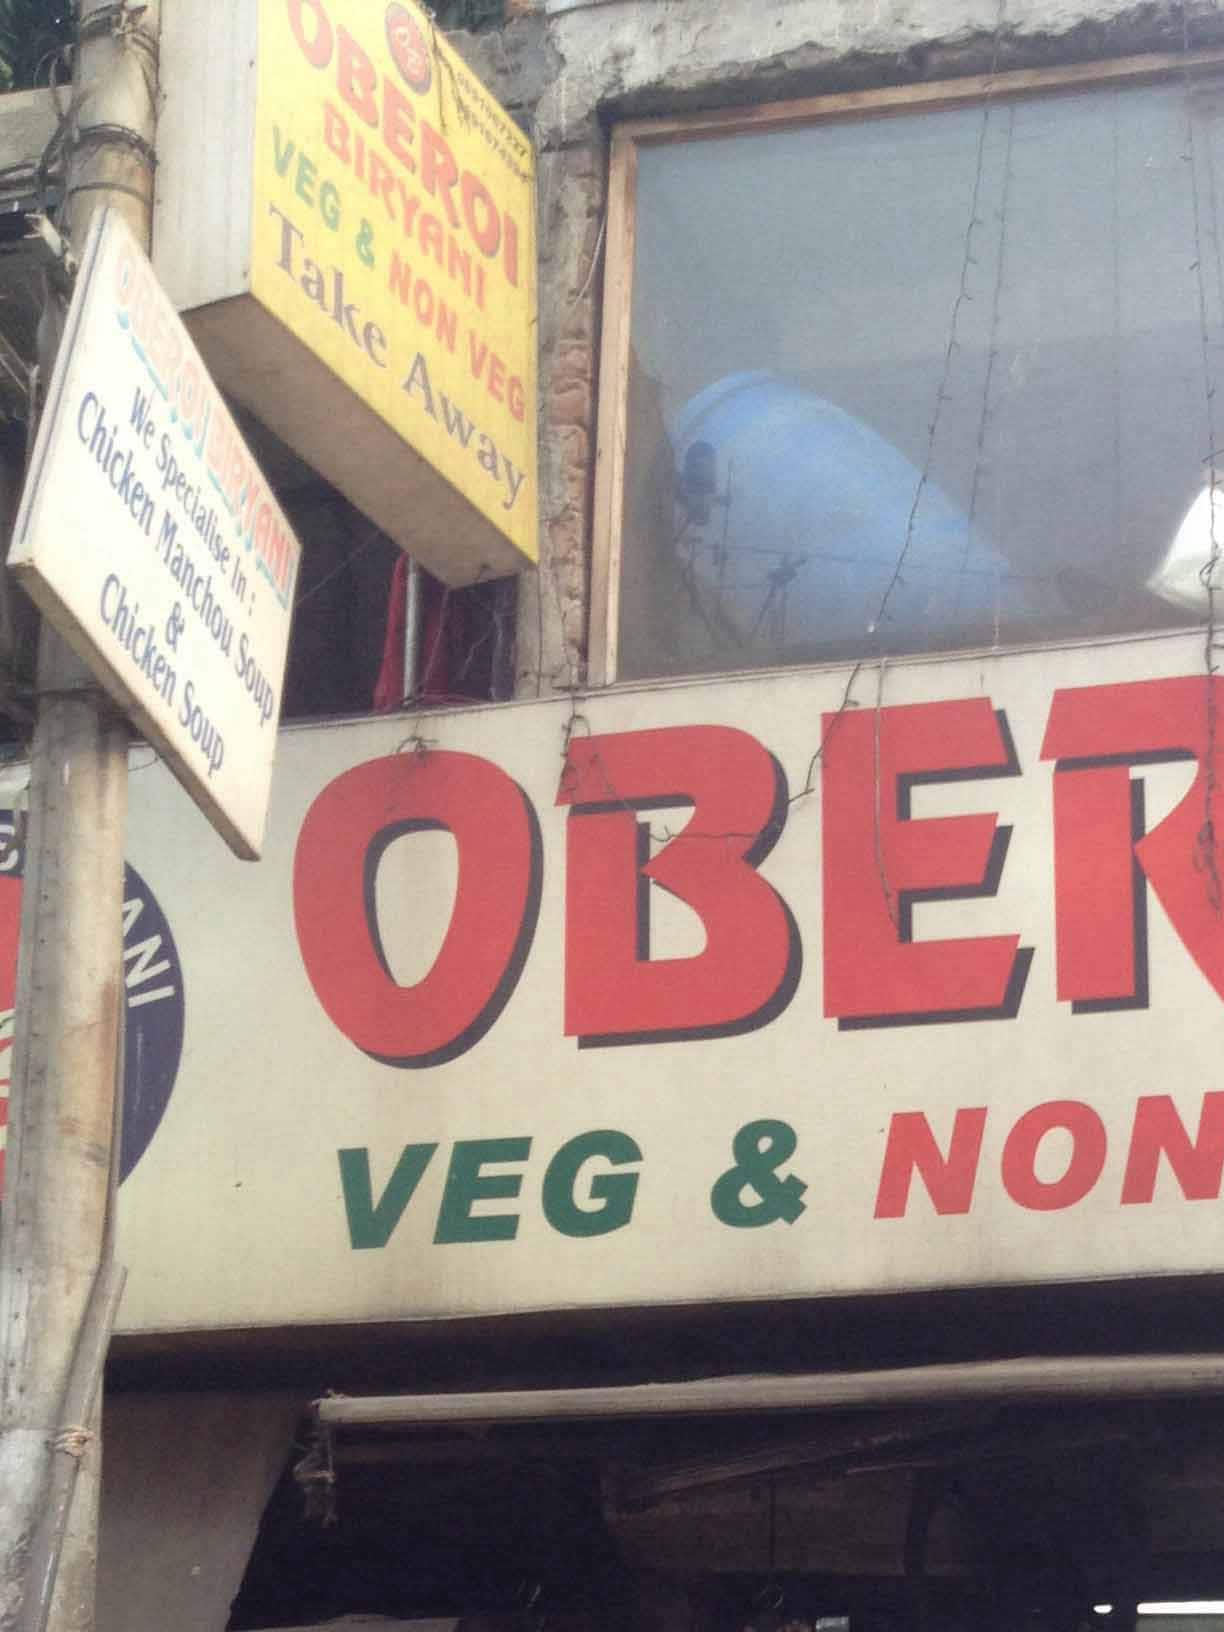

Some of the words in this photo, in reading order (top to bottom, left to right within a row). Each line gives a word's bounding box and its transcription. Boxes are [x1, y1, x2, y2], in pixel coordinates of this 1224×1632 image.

[287, 0, 518, 288] OBEROI
[323, 100, 486, 311] BIRYANI
[269, 201, 387, 369] Take
[402, 351, 528, 511] Away
[273, 124, 341, 232] VEG
[355, 217, 375, 269] &
[388, 249, 458, 353] NON
[468, 329, 526, 424] VEG
[77, 391, 156, 537] Chicken
[235, 632, 275, 728] Soup
[130, 386, 156, 449] We
[156, 433, 231, 574] Specialise
[100, 573, 178, 707] Chicken
[178, 680, 225, 779] Soup
[165, 601, 185, 653] &
[338, 1129, 643, 1250] VEG
[711, 1119, 808, 1228] &
